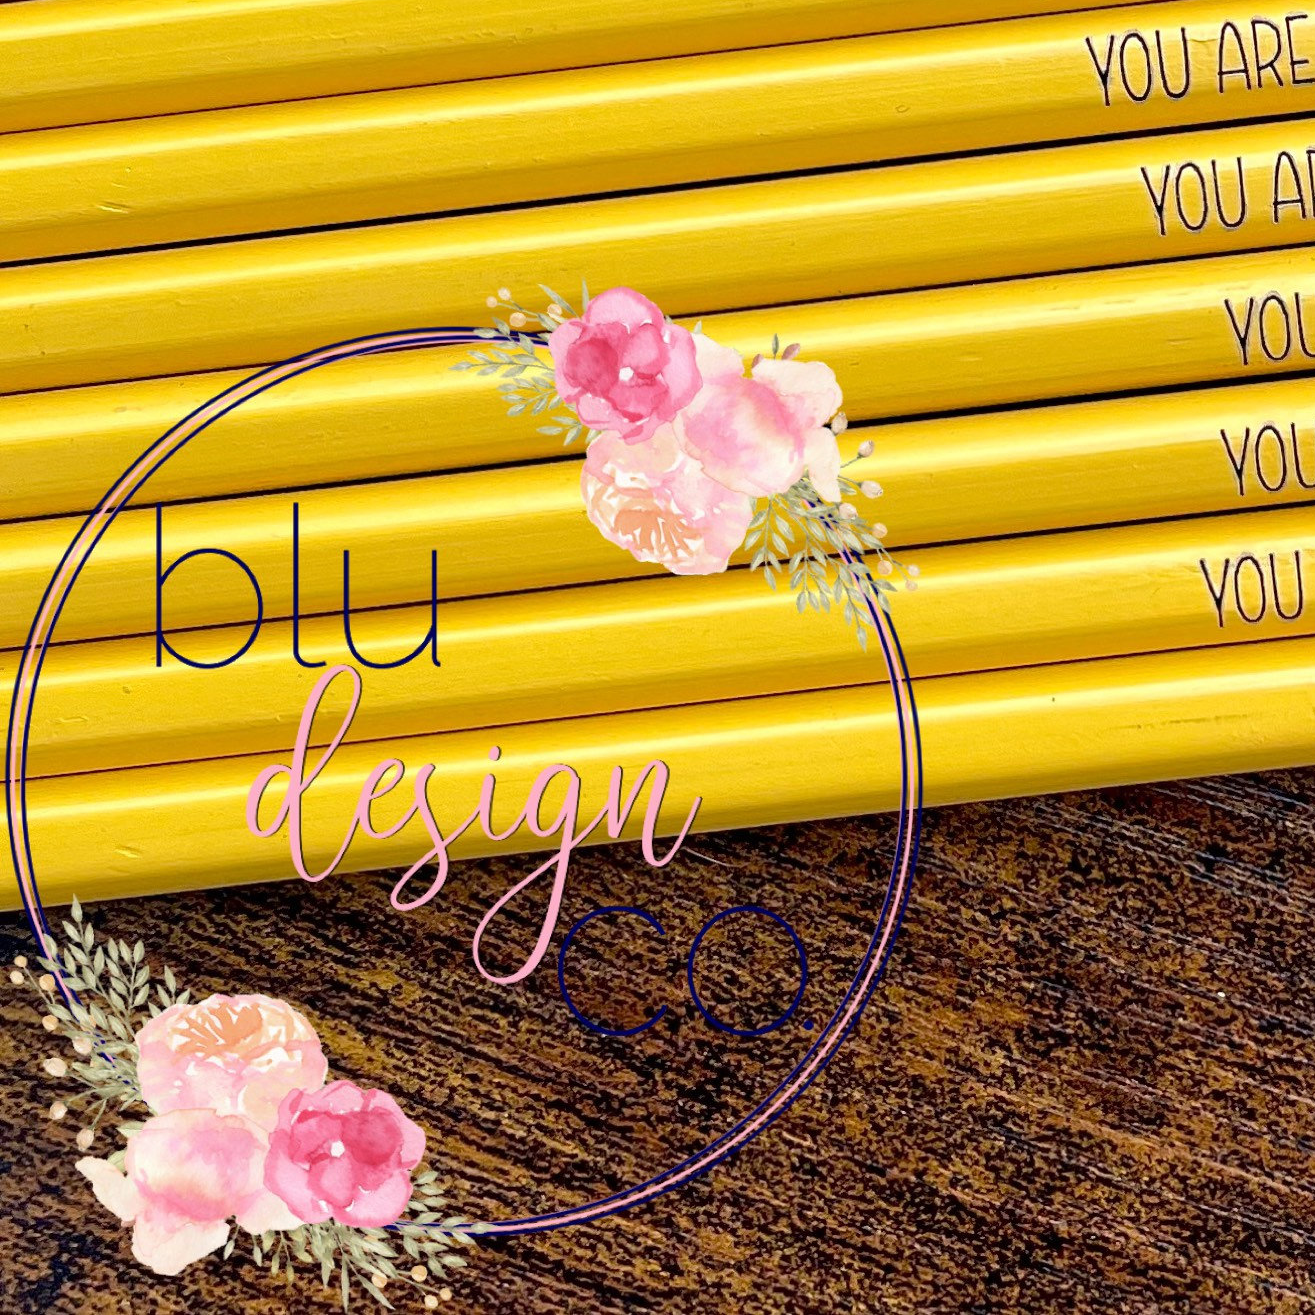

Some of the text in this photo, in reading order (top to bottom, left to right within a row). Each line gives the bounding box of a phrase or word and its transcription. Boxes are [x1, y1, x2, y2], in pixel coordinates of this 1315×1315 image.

[1085, 27, 1191, 108] YOU
[1140, 156, 1247, 237] YOU
[1199, 550, 1304, 629] YOU
